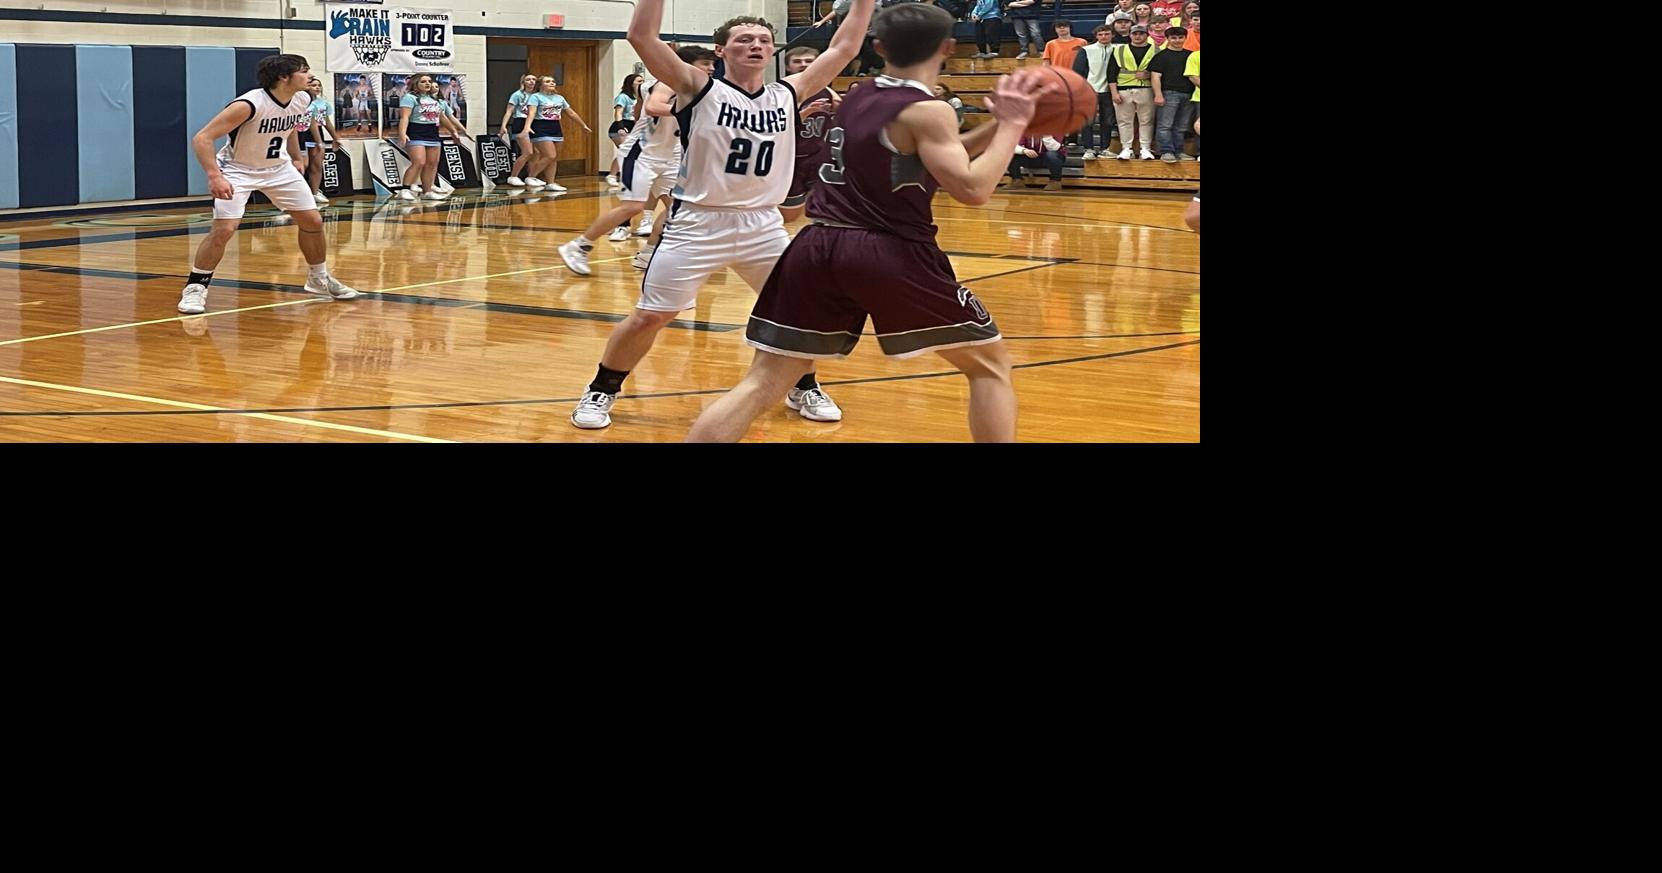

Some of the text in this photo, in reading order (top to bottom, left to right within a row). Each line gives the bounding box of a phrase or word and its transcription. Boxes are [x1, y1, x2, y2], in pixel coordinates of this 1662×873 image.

[349, 8, 389, 19] MAKE IT
[395, 12, 421, 20] 3-POINT
[349, 18, 390, 36] RAIN
[405, 27, 442, 43] 102
[349, 36, 392, 45] HAWKS
[266, 136, 283, 160] 2
[481, 142, 499, 179] LOUD
[495, 146, 511, 172] GET
[725, 137, 775, 177] 20
[323, 151, 339, 188] LET'S
[381, 148, 400, 188] WHITE
[444, 146, 466, 181] FENSE
